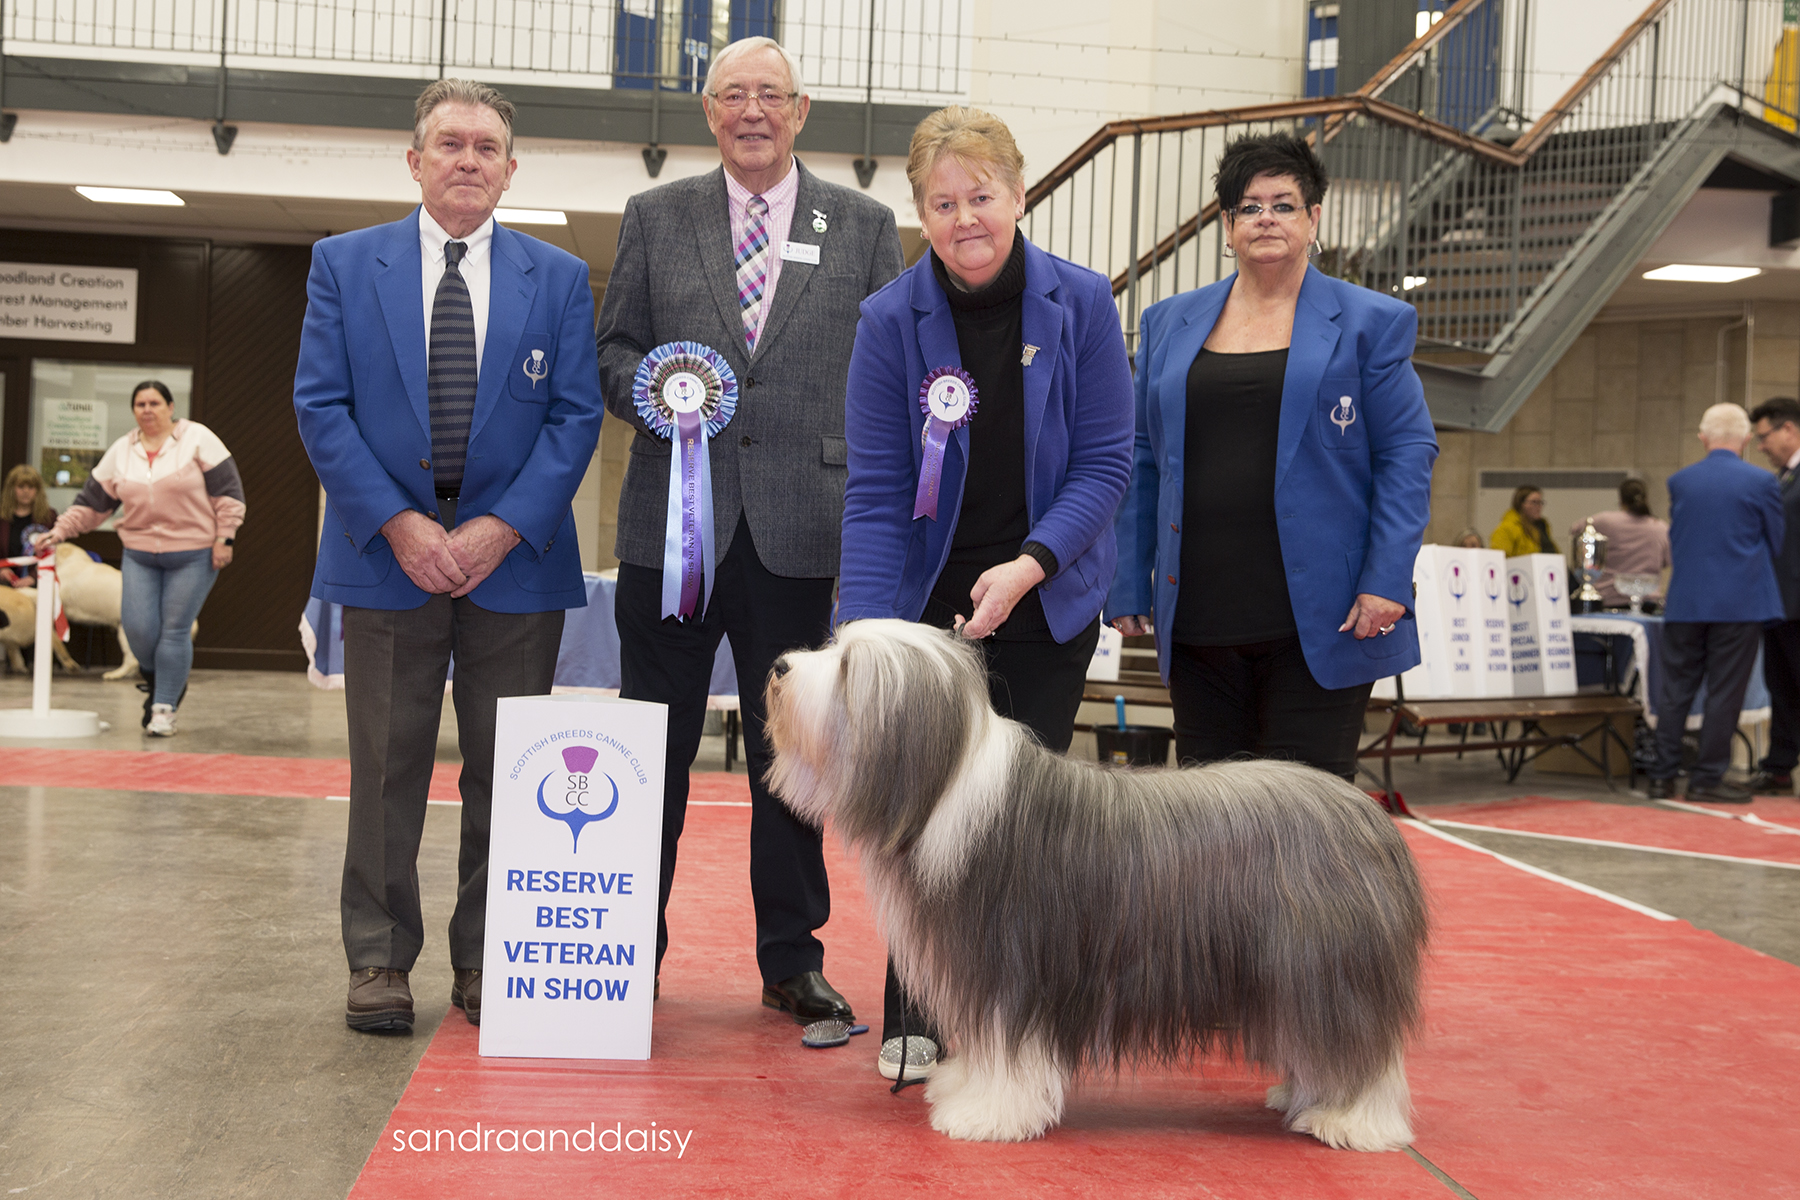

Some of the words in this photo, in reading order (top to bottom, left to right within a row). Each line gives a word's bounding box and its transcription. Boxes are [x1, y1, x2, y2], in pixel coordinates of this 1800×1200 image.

[795, 249, 816, 257] JUDGE
[60, 272, 124, 289] Creation
[30, 295, 128, 312] Management
[34, 314, 112, 335] Harvesting
[687, 438, 695, 480] RESERVE
[928, 462, 937, 497] VETERAN
[688, 551, 694, 560] IN
[509, 737, 549, 781] SCOTTISH
[550, 729, 594, 743] BREEDS
[595, 733, 633, 760] CANINE
[629, 758, 648, 785] CLUB
[567, 775, 589, 790] SB
[565, 791, 589, 806] CC
[506, 869, 634, 895] RESERVE
[536, 906, 609, 930] BEST
[503, 941, 635, 966] VETERAN
[506, 976, 535, 999] IN
[543, 977, 630, 1002] SHOW
